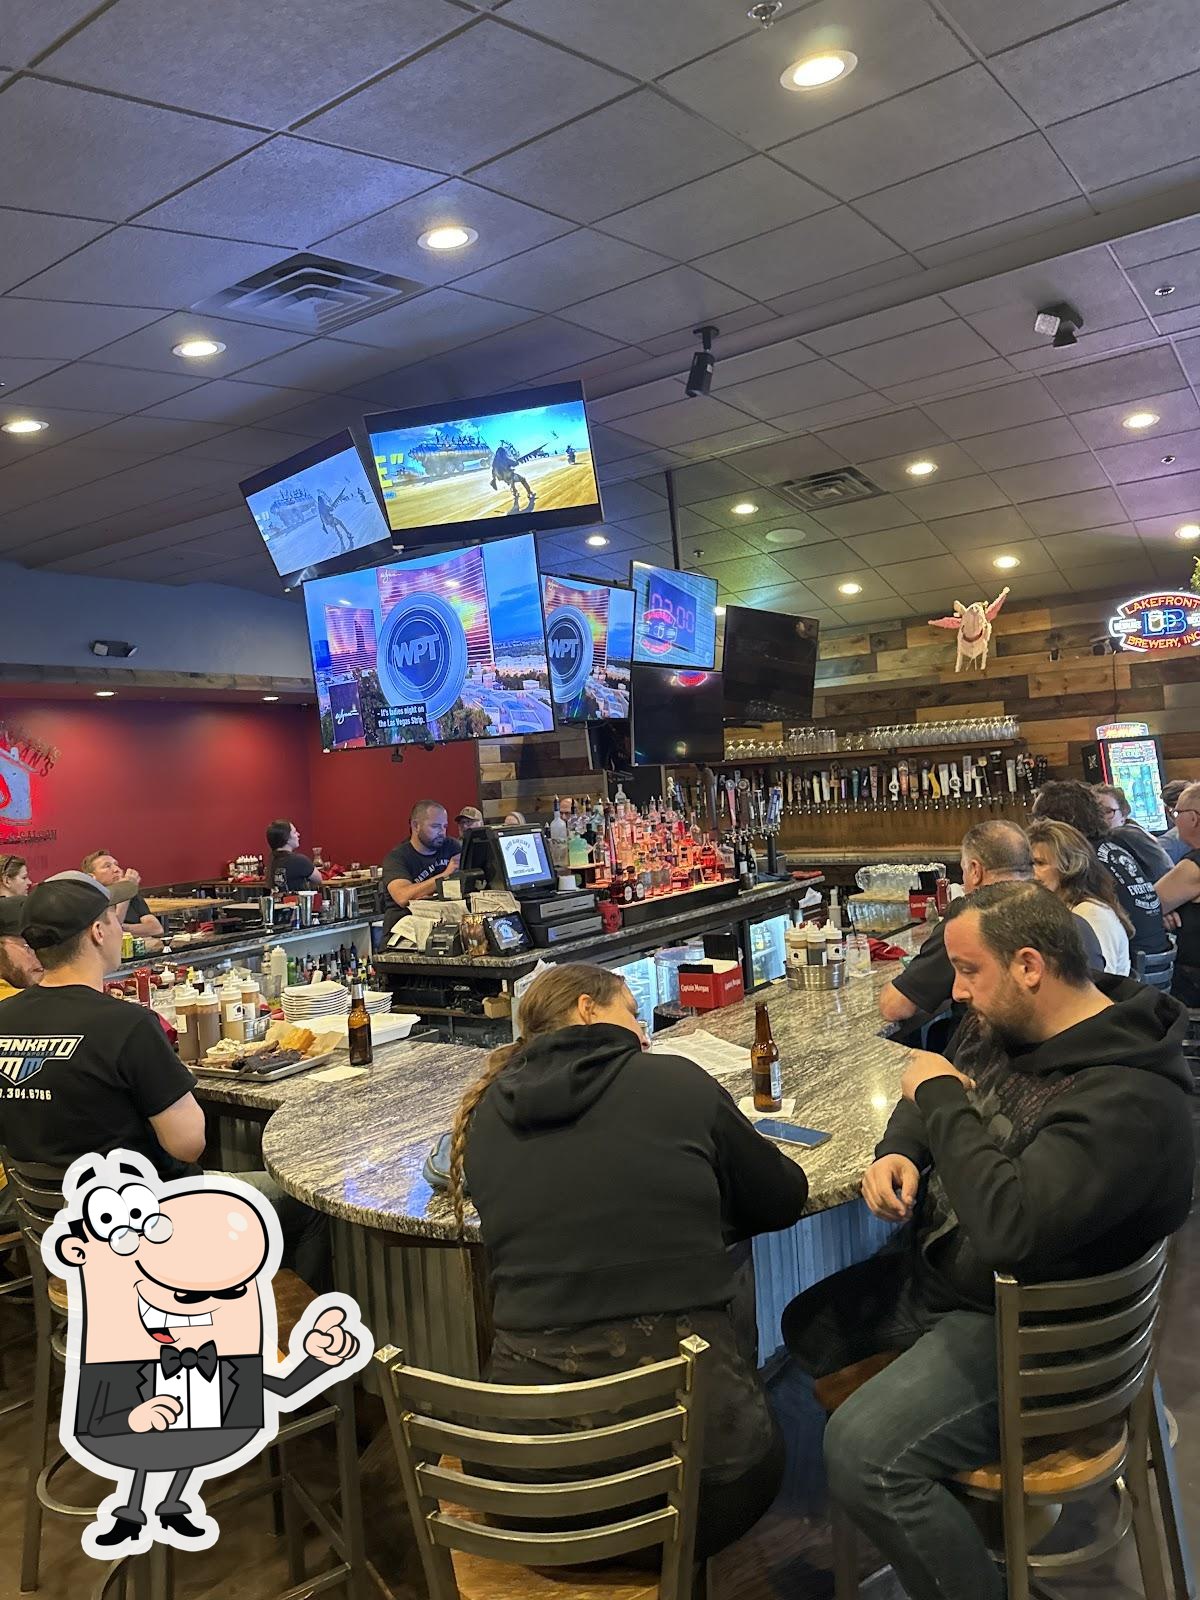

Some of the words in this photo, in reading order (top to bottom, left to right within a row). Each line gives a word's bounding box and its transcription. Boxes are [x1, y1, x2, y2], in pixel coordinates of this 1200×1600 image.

[1124, 596, 1200, 615] LAKEFRONT
[391, 633, 441, 668] WPT
[549, 638, 580, 659] WPT
[1127, 635, 1182, 649] BREWERY,
[0, 1038, 78, 1056] ANKATO
